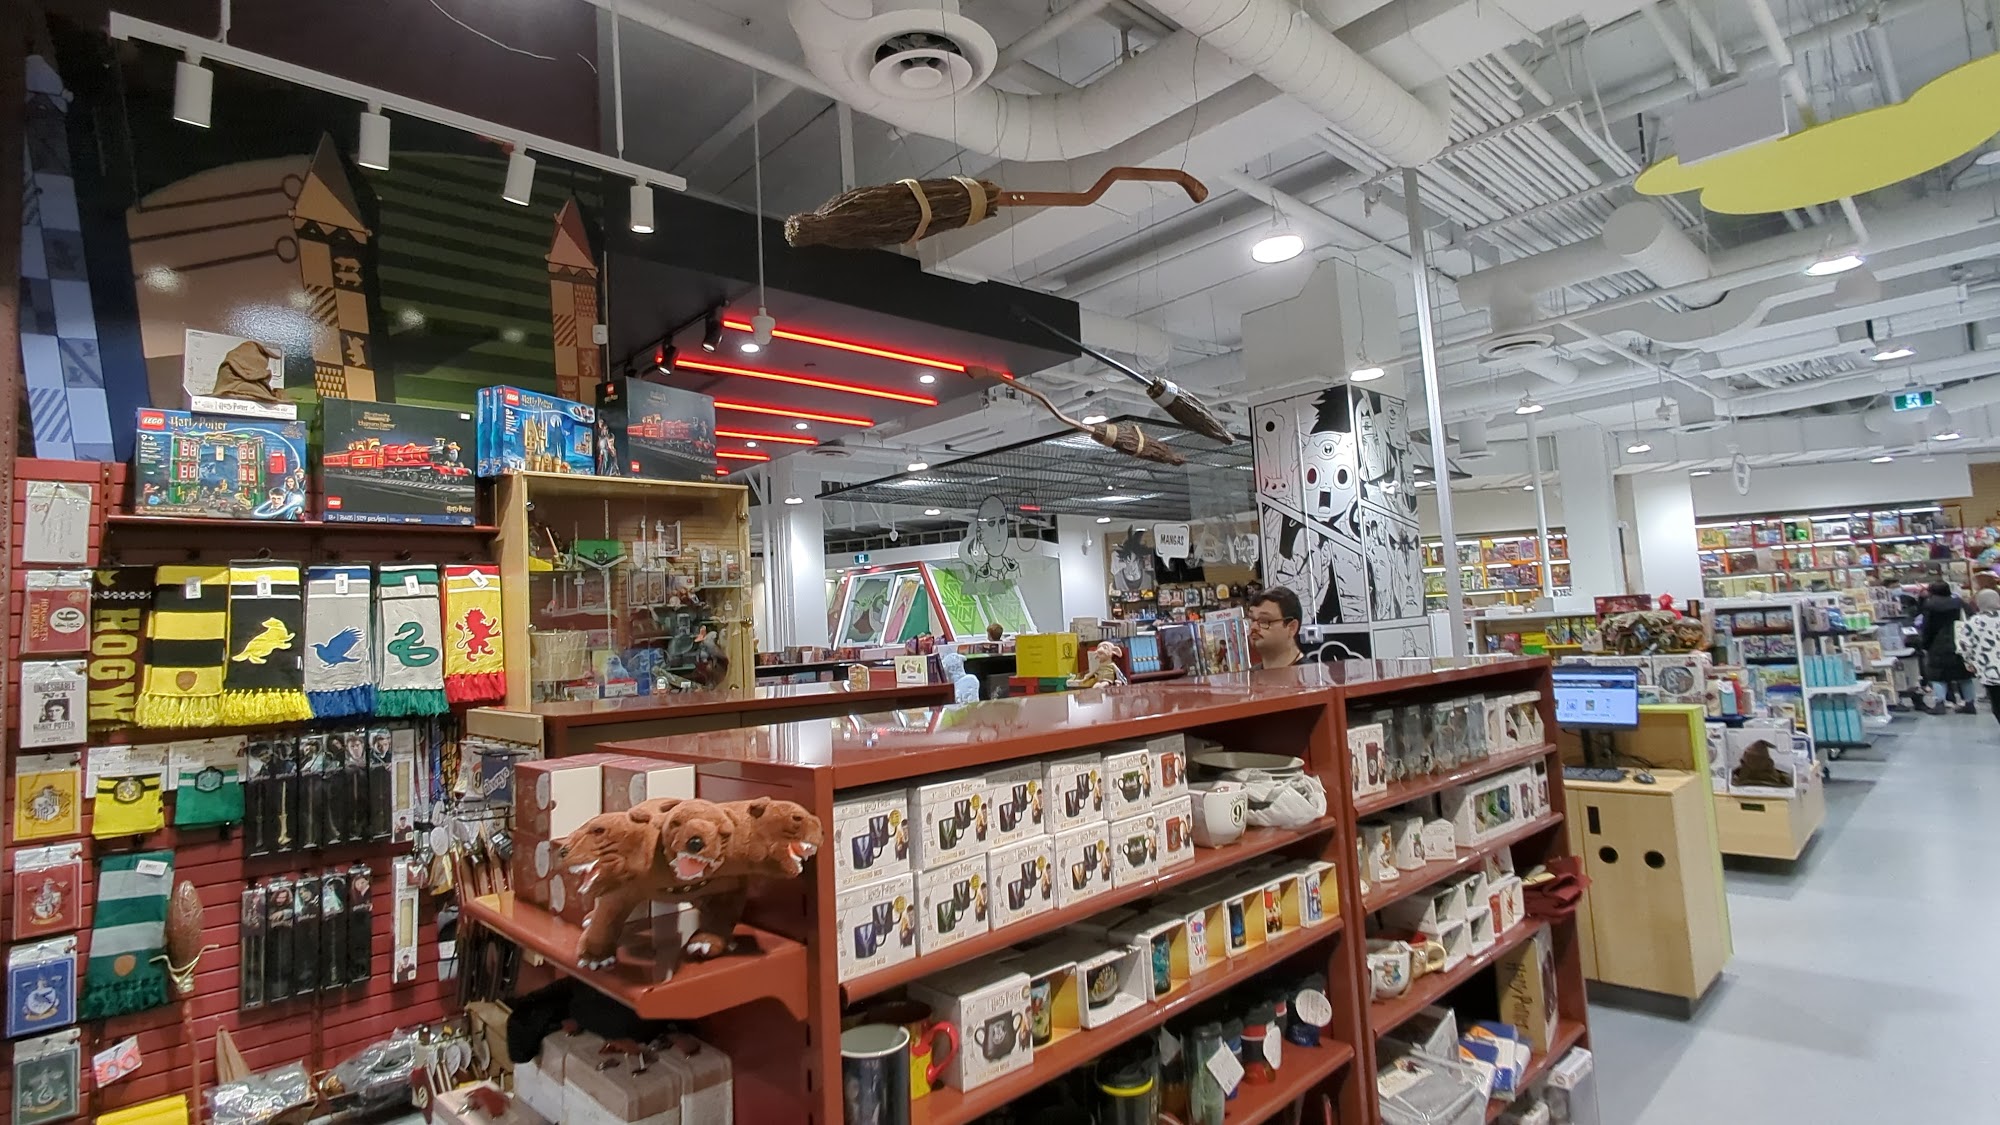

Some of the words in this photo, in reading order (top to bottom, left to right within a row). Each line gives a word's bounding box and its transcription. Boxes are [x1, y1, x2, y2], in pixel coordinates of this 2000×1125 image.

[141, 416, 165, 426] LEGO
[168, 416, 198, 430] Harry
[199, 416, 228, 430] Potter
[1160, 533, 1185, 546] MANGAS
[31, 603, 40, 639] EXPRESS
[40, 598, 49, 641] HOGWARTS
[89, 608, 141, 722] HOGW
[33, 681, 76, 693] UNDESIRABLE
[33, 722, 52, 732] HARRY
[53, 721, 76, 731] POTTER
